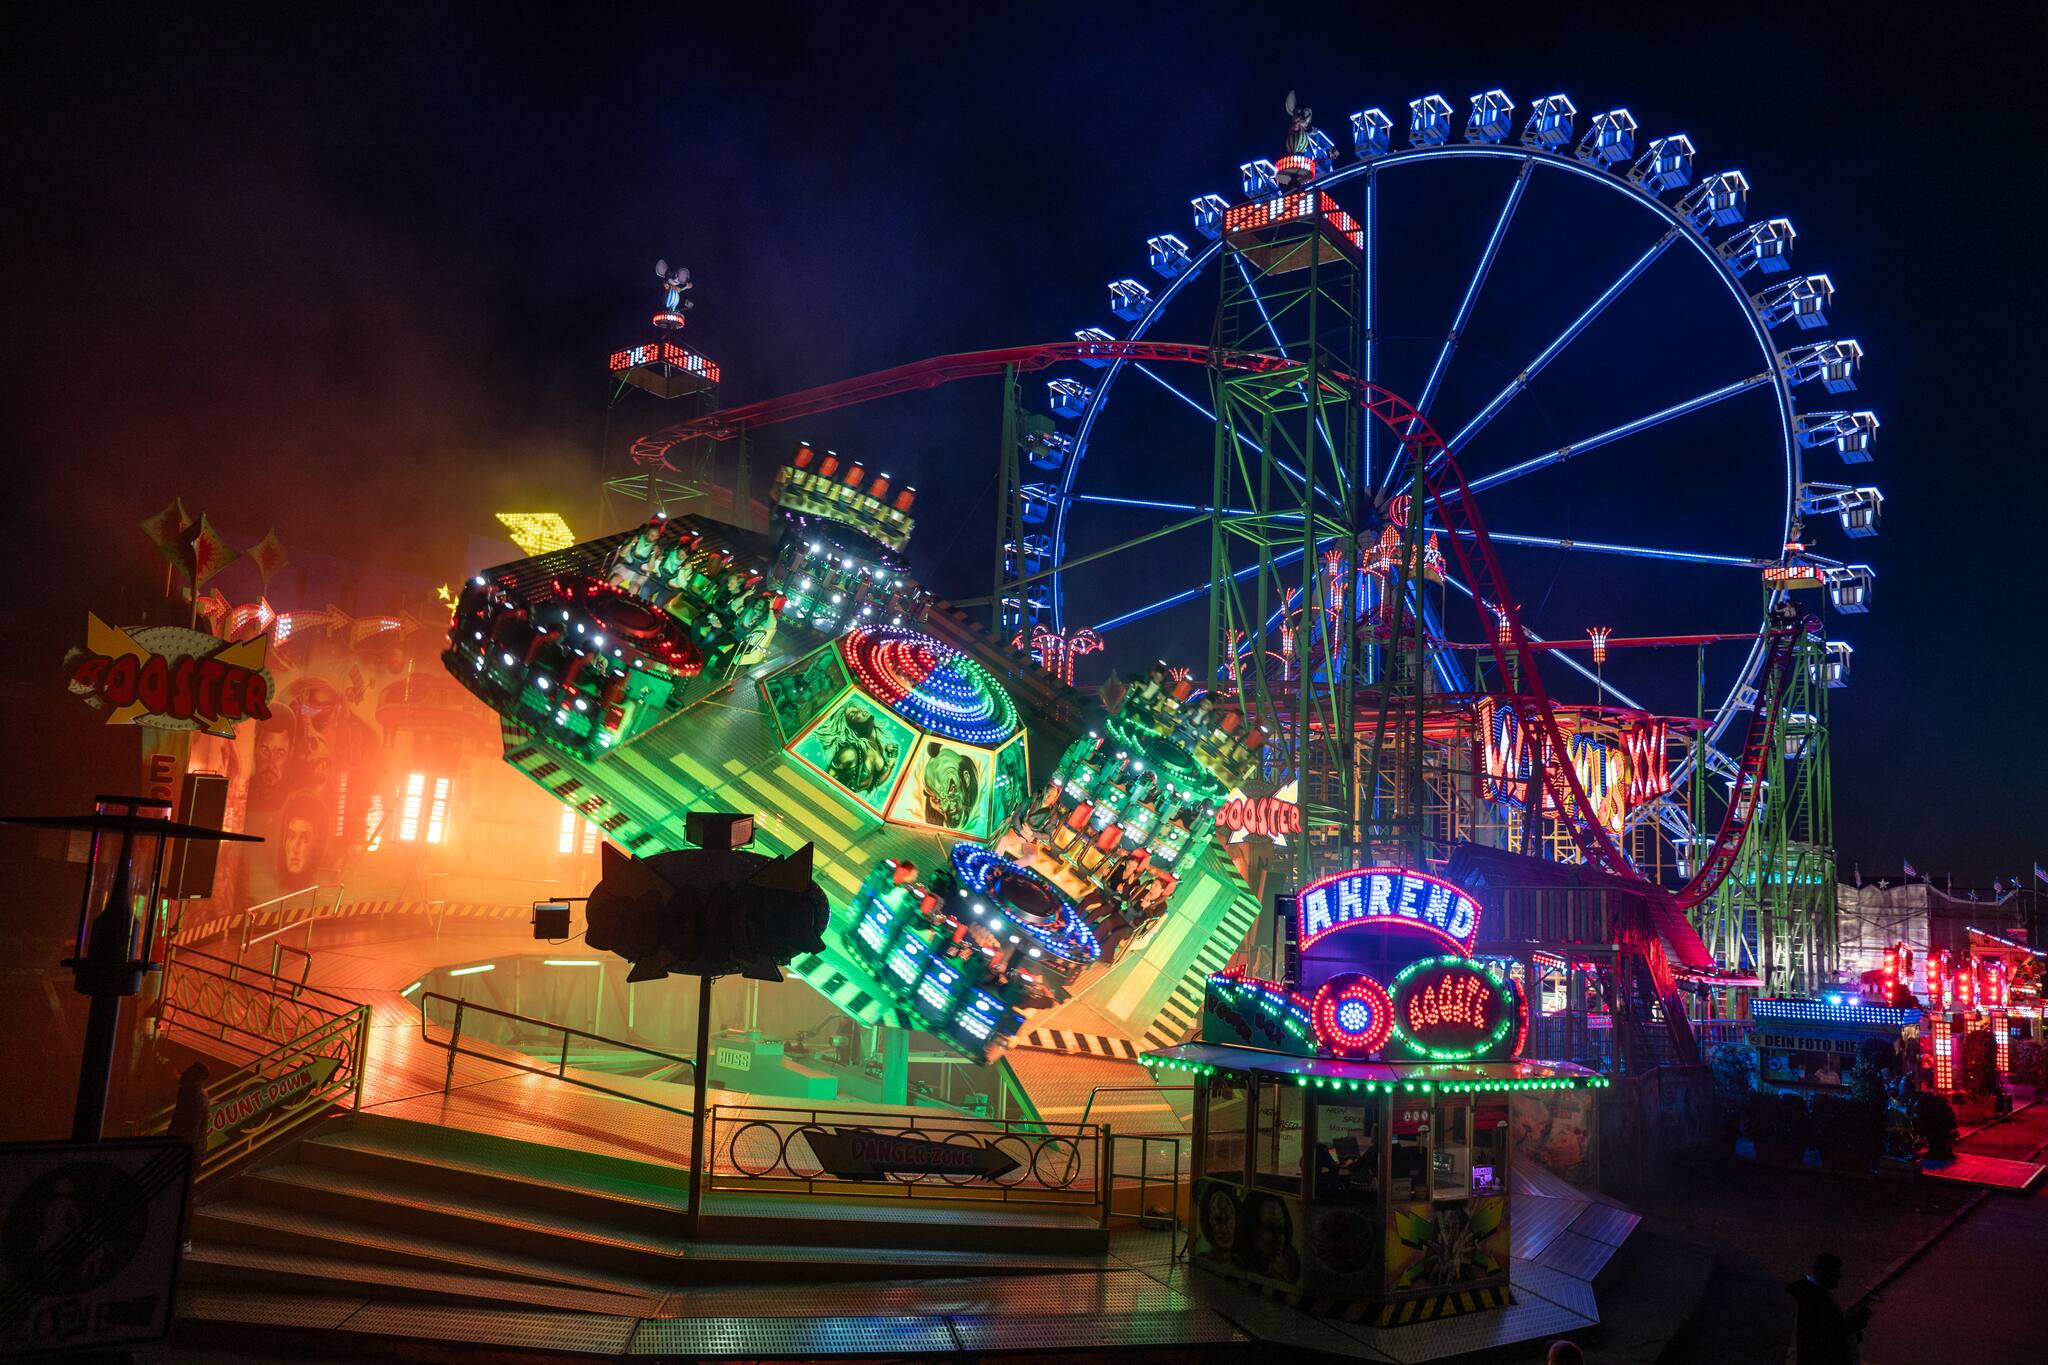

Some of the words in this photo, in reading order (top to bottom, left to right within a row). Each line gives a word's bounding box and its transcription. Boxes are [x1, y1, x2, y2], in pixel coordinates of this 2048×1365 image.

[73, 653, 273, 723] BOOSTER
[1624, 722, 1671, 804] XXL
[1215, 797, 1302, 837] BOOSTER
[1306, 874, 1476, 939] AHREND
[719, 1050, 751, 1068] HUSS
[1765, 1035, 1794, 1048] DEIN
[1798, 1038, 1831, 1051] FOTO
[1835, 1040, 1857, 1053] HIE
[851, 1137, 929, 1165] DANGER
[930, 1147, 973, 1167] ZONE
